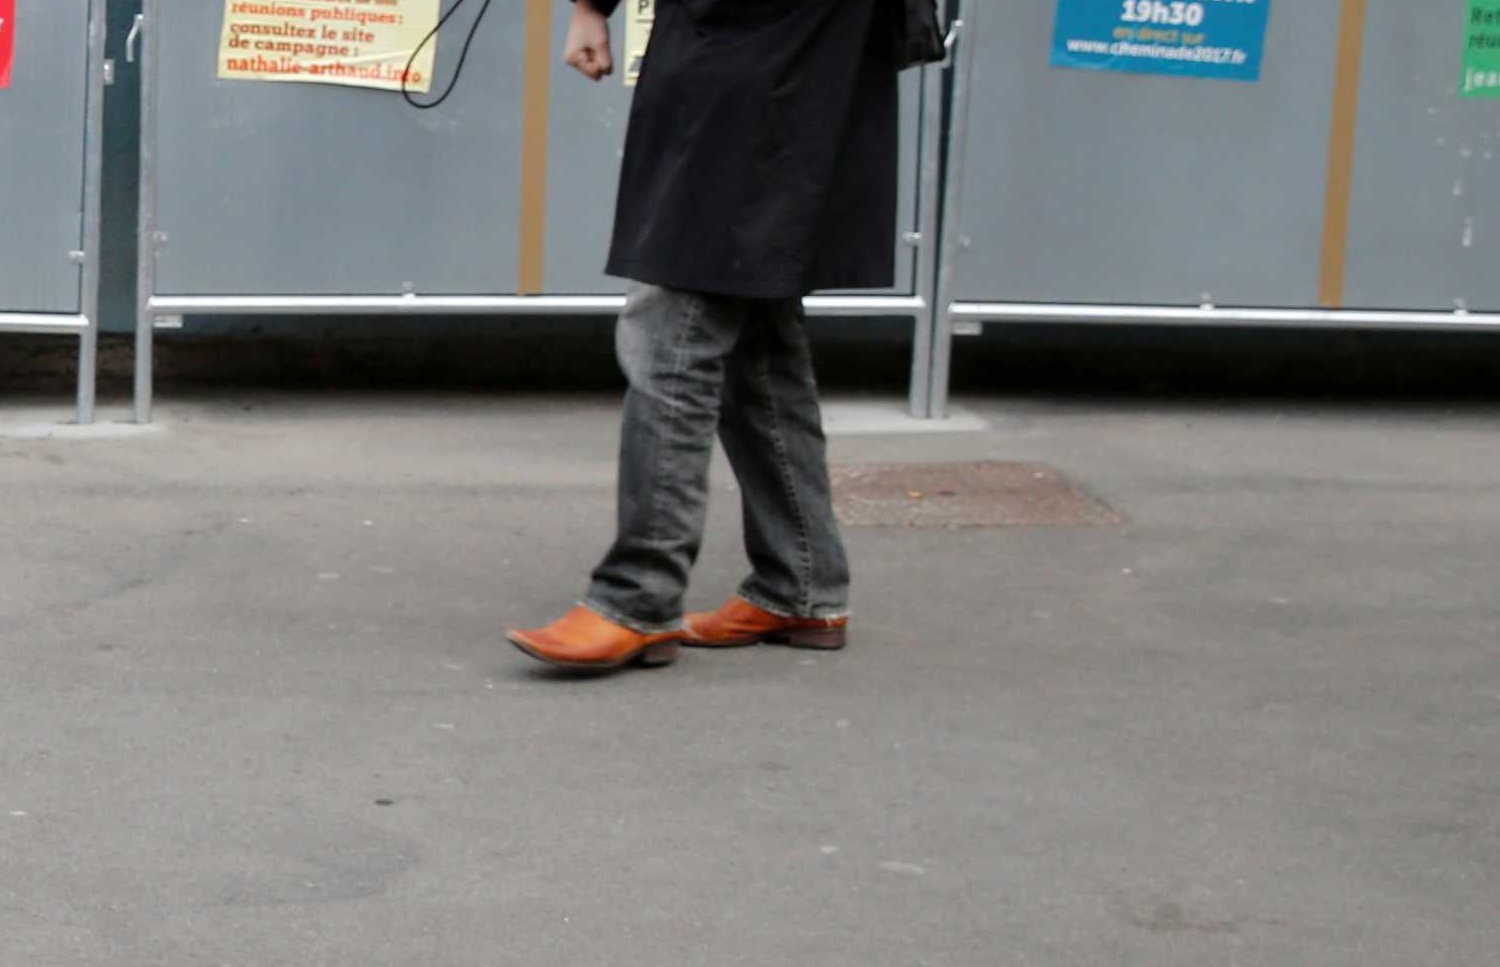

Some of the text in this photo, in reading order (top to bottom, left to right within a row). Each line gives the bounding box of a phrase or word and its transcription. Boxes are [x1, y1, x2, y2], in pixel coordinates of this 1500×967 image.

[231, 1, 306, 18] réunions
[230, 22, 375, 43] consultez le site
[228, 35, 251, 50] de
[255, 39, 349, 57] campagne
[227, 56, 422, 84] nathalie-arthaud.info
